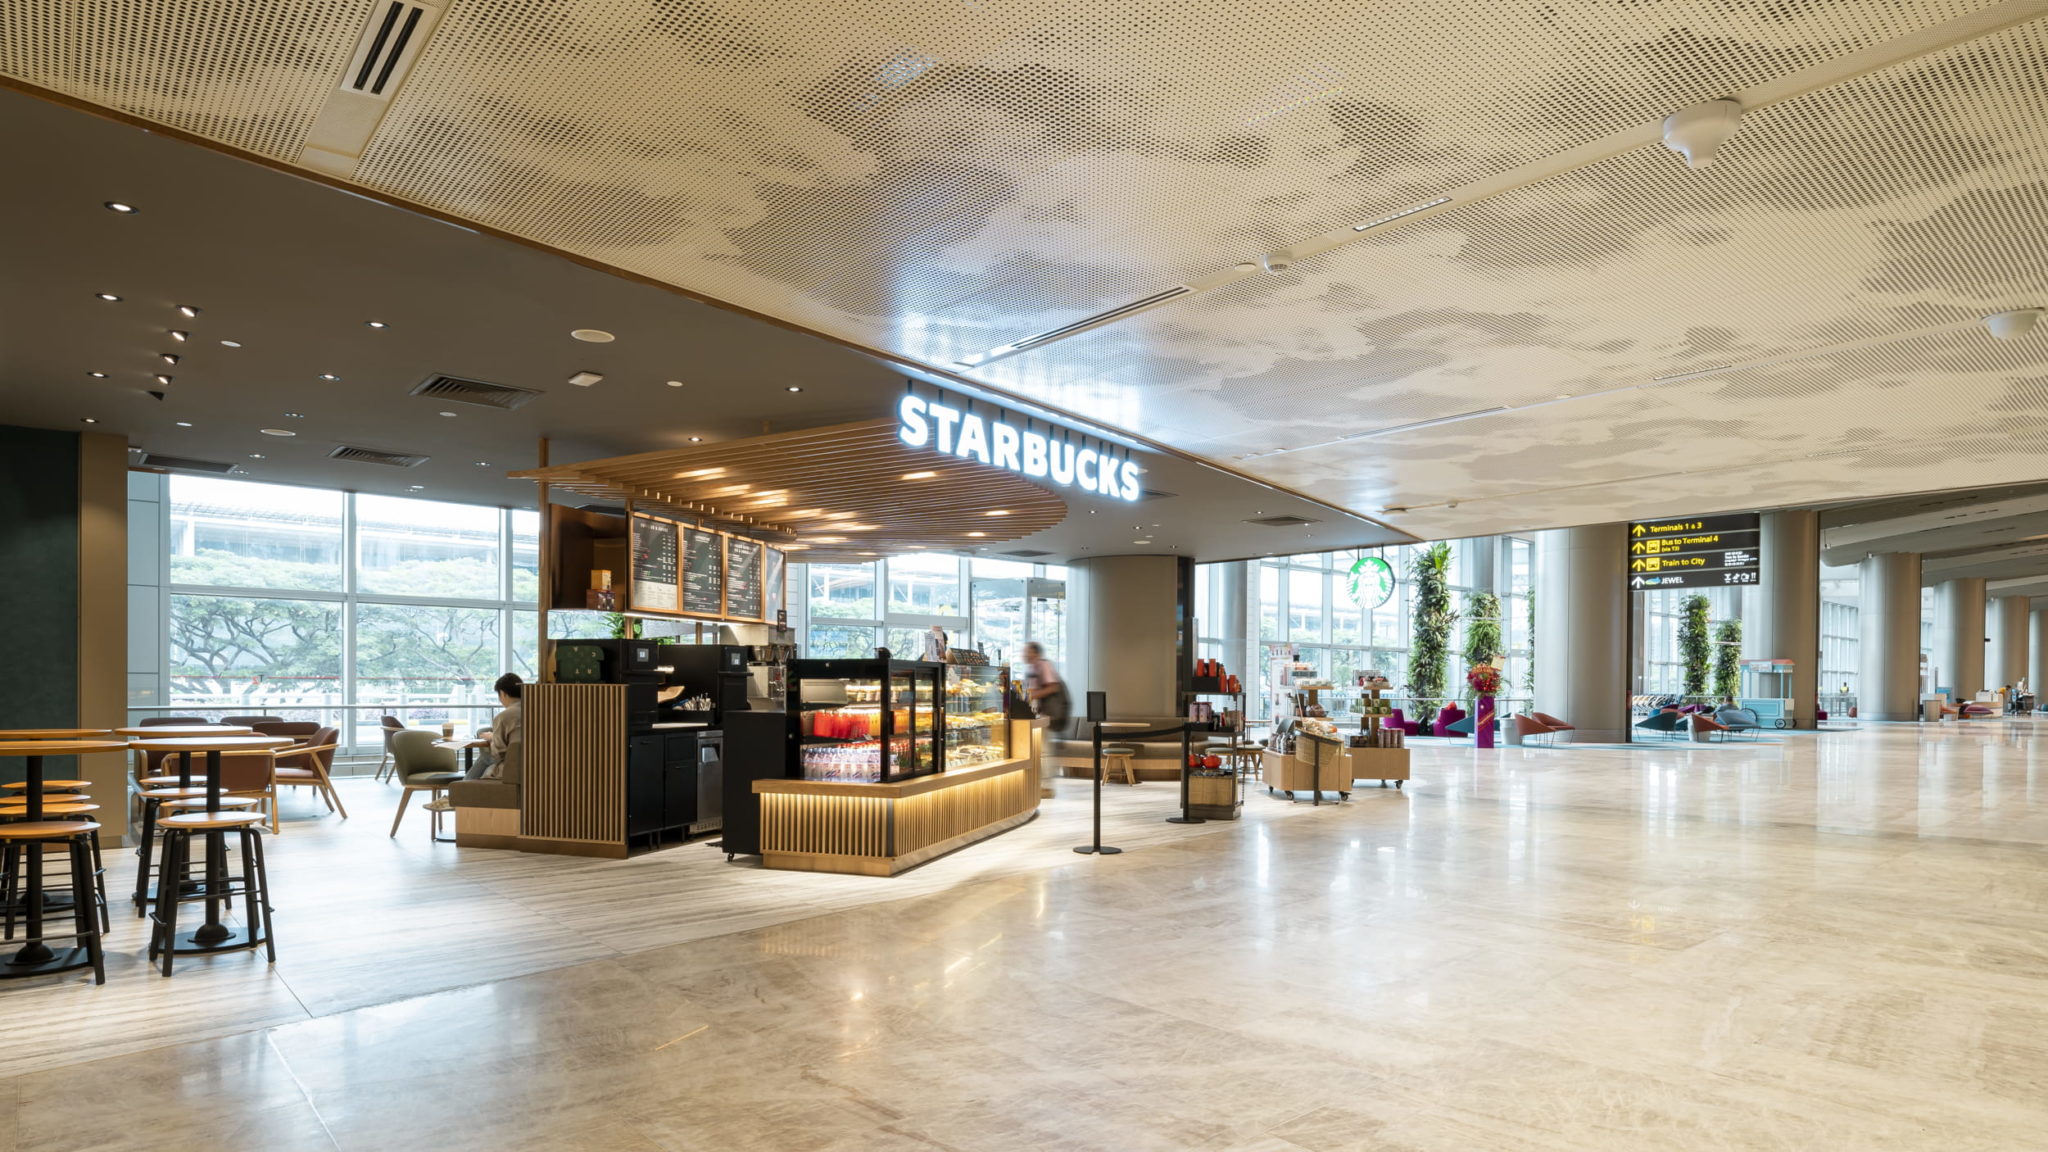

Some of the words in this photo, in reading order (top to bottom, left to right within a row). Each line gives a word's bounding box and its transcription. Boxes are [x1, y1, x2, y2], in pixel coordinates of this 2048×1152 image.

[899, 395, 1140, 502] STARBUCKS
[1650, 523, 1683, 533] Terminals
[1697, 521, 1703, 529] 3
[1682, 536, 1712, 545] Terminal
[1662, 559, 1680, 567] Train
[1690, 557, 1706, 566] City
[1661, 576, 1684, 584] JEWEL
